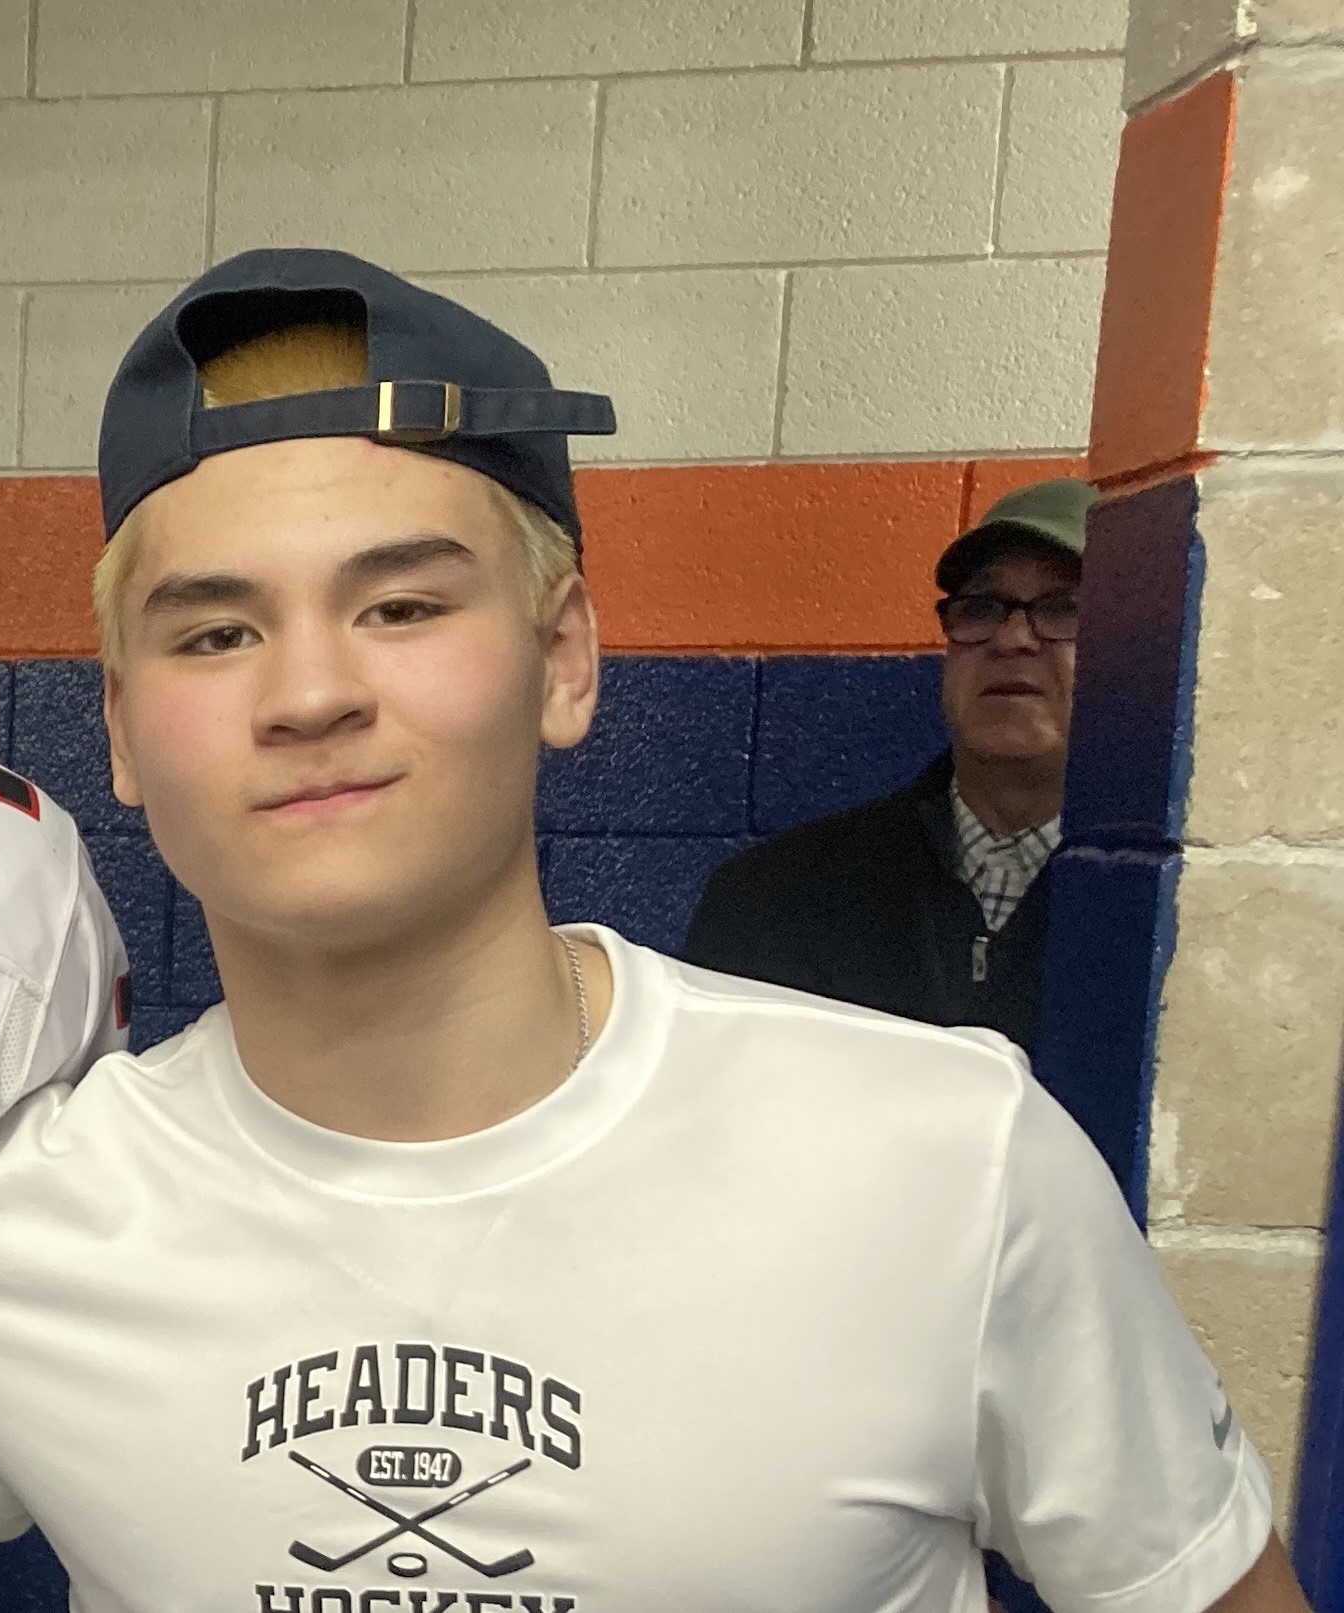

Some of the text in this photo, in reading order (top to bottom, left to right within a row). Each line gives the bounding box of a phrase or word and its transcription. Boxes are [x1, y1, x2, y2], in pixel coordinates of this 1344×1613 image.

[241, 1344, 582, 1470] HEADERS
[369, 1450, 452, 1482] EST. 1947
